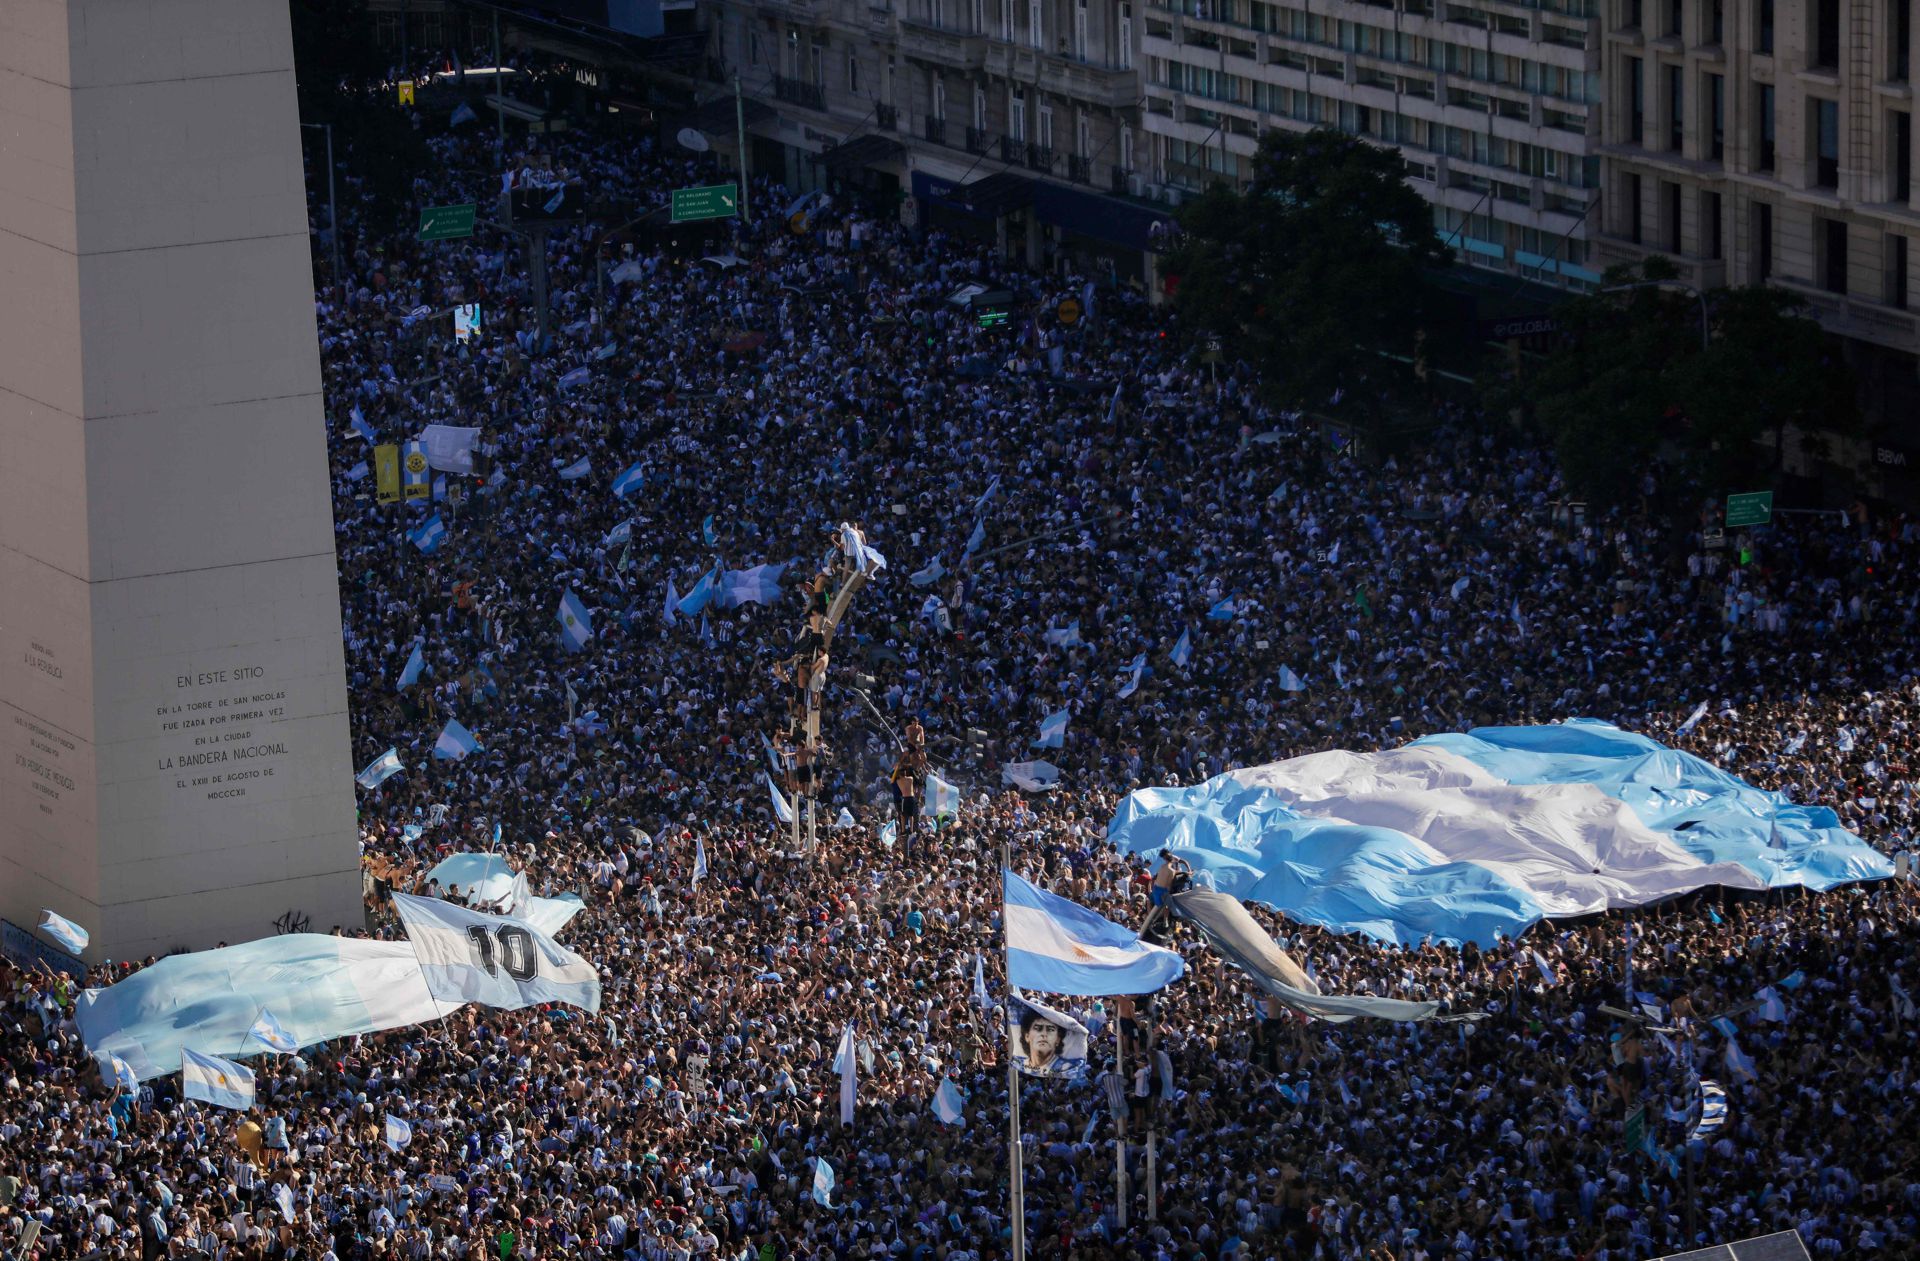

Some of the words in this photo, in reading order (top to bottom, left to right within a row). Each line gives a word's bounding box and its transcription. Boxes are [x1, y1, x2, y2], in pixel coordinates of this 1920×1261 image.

[576, 69, 597, 86] ALMA
[1877, 448, 1906, 467] BBVA
[177, 676, 192, 687] EN
[199, 671, 227, 685] ESTE
[234, 667, 263, 680] SITIO
[187, 701, 212, 710] TORRE
[218, 699, 228, 707] DE
[253, 692, 286, 702] NICOLAS
[163, 722, 178, 730] FUE
[183, 719, 205, 728] IZADA
[210, 716, 226, 724] POR
[231, 711, 263, 721] PRIMERA
[269, 708, 284, 716] VEZ
[224, 732, 251, 742] CIUDAD
[159, 758, 173, 770] LA
[180, 751, 228, 767] BANDERA
[234, 744, 288, 760] NACIONAL
[177, 780, 186, 788] EL
[192, 777, 208, 786] XXIII
[228, 770, 259, 781] AGOSTO
[264, 768, 274, 776] DE
[208, 789, 245, 800] MDCCCXII
[466, 923, 538, 983] 10
